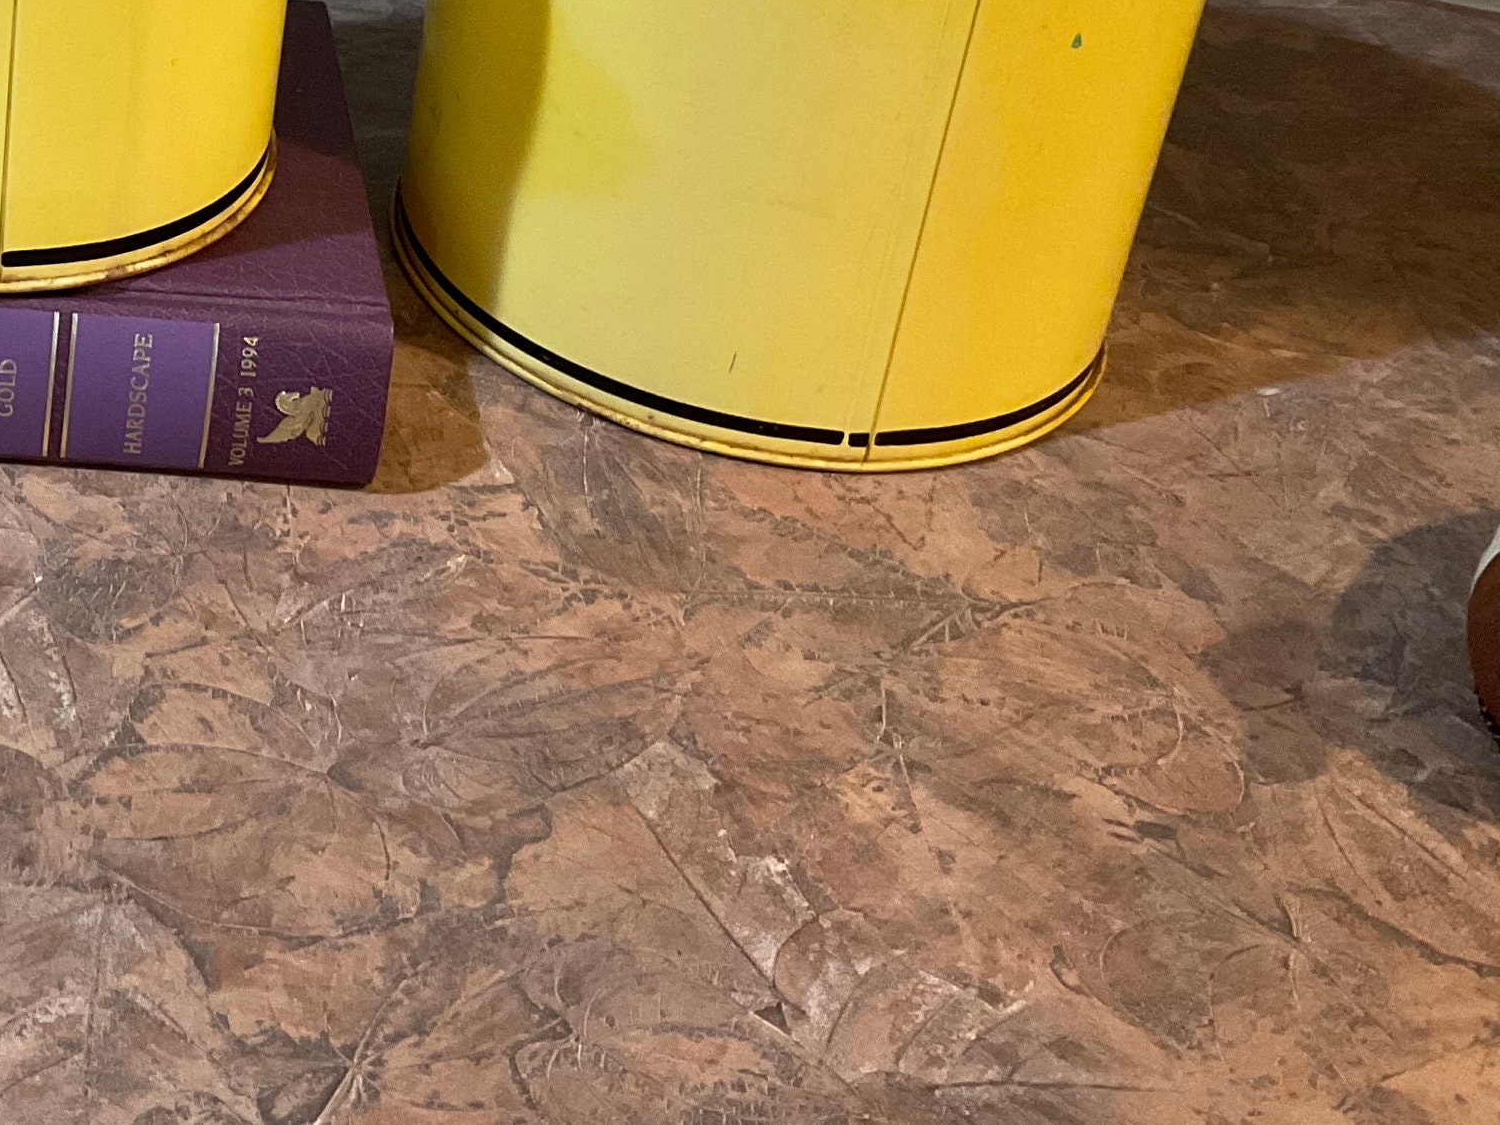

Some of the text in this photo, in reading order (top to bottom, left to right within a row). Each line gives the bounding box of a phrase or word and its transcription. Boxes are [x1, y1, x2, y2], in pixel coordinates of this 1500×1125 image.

[123, 333, 153, 454] HARDSCAPE
[228, 336, 259, 466] VOLUME 3 1994
